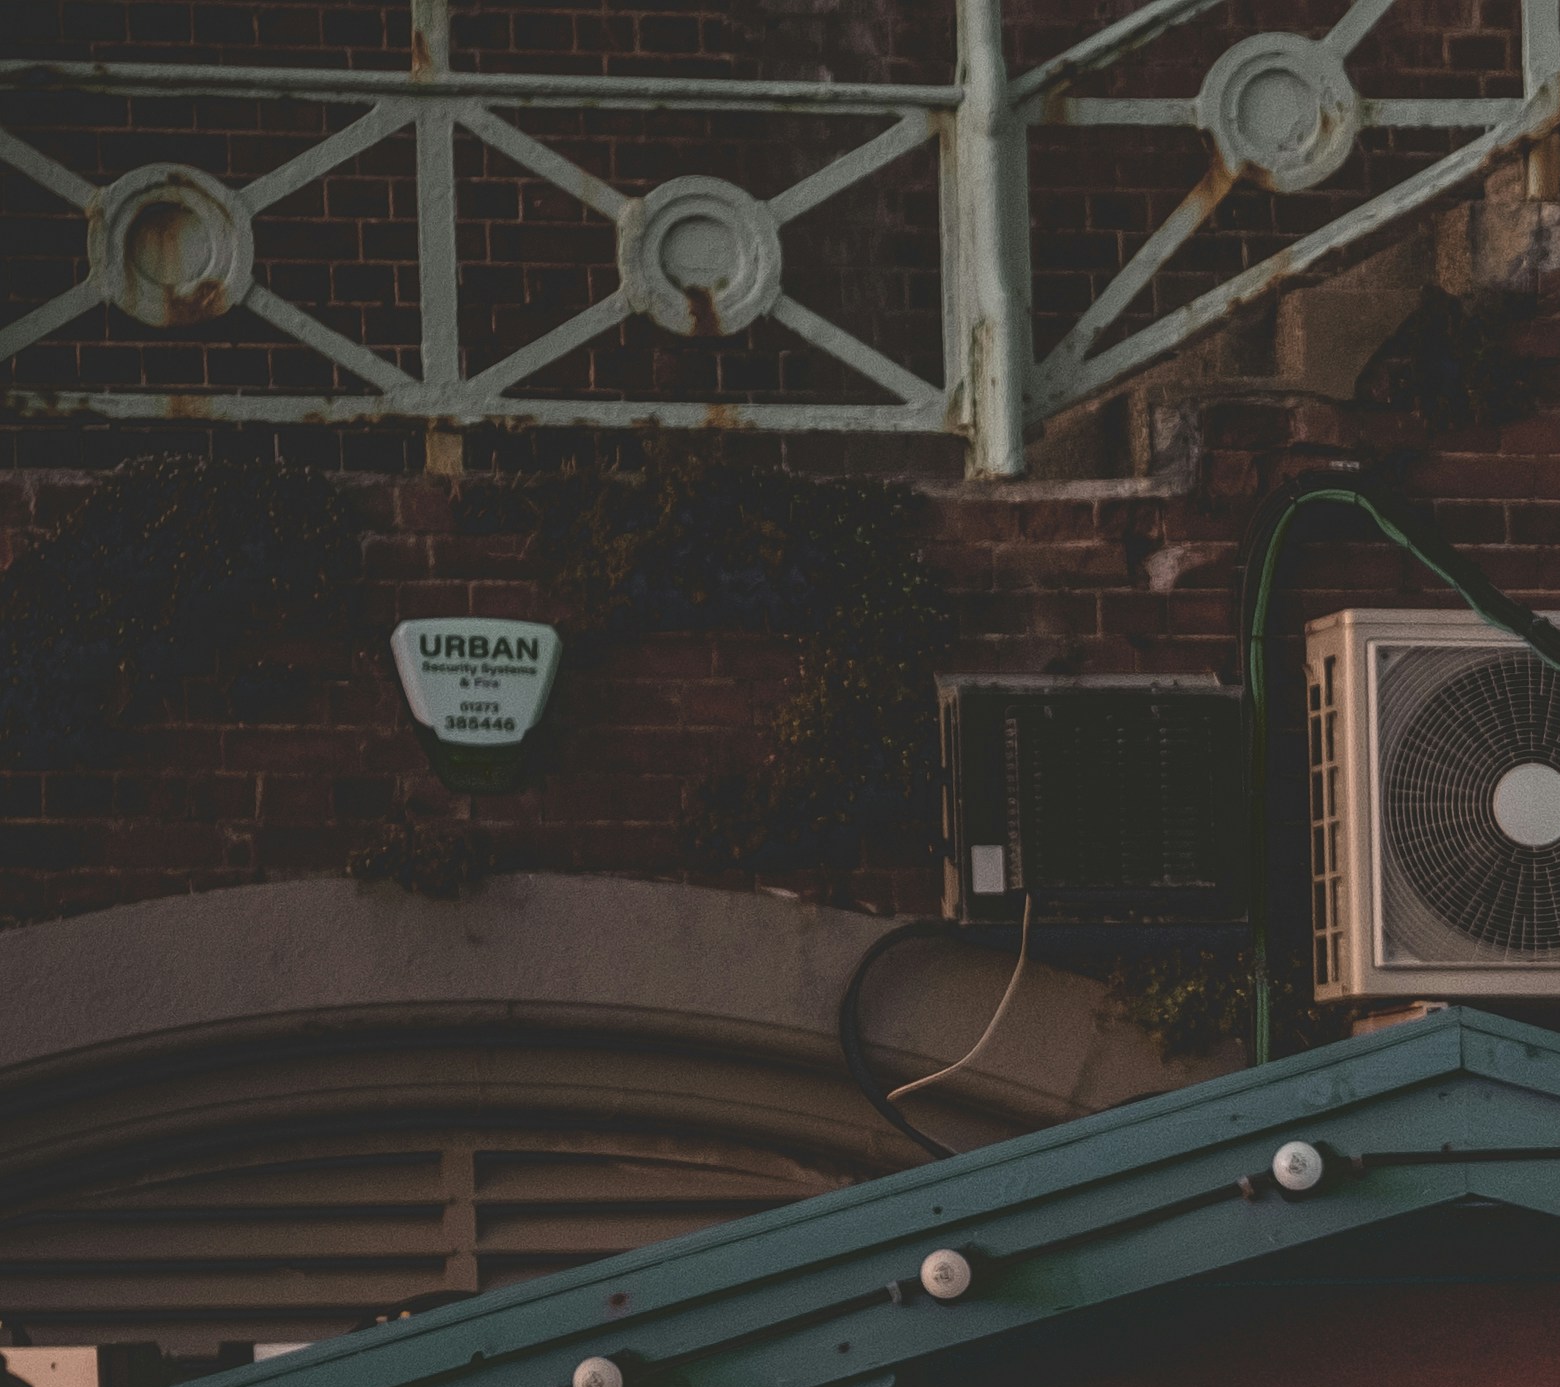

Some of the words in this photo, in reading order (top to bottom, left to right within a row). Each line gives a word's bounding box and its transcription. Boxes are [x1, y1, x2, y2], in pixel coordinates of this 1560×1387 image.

[420, 634, 539, 661] URBAN
[422, 661, 477, 675] Security
[481, 662, 538, 676] Systems
